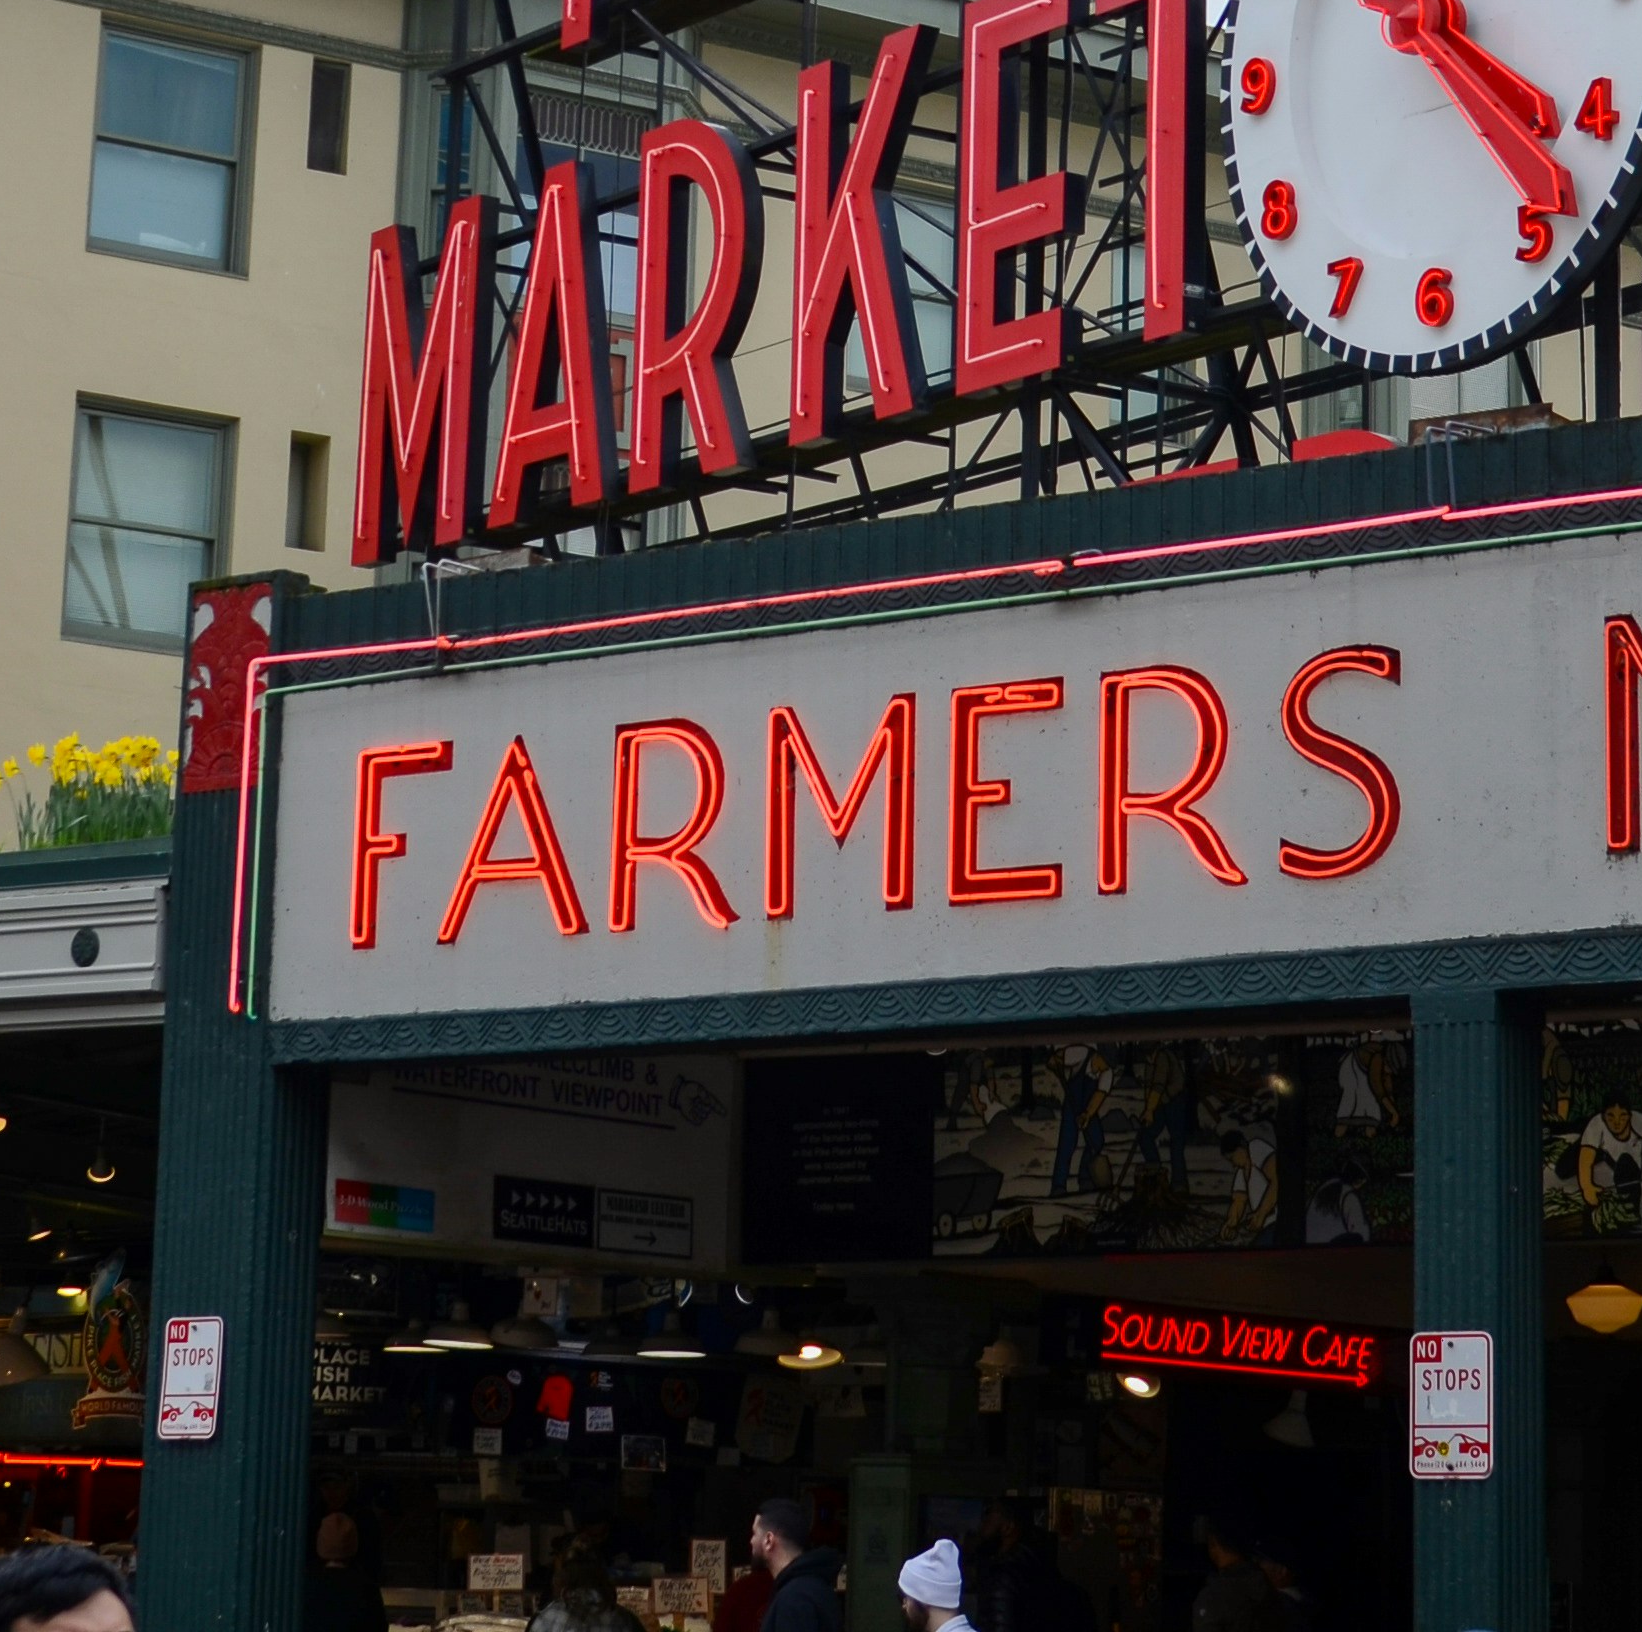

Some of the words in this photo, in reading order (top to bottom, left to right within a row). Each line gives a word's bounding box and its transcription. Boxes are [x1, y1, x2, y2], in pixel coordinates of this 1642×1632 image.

[1240, 57, 1276, 116] 9
[1575, 77, 1620, 141] 4
[1261, 179, 1298, 241] 8
[1515, 206, 1554, 263] 5
[1327, 257, 1364, 319] 7
[1415, 268, 1454, 328] 6
[350, 643, 1402, 949] FARMERS
[551, 1079, 663, 1117] VIEWPOINT
[645, 1063, 658, 1085] &
[170, 1324, 186, 1339] NO
[173, 1348, 214, 1366] STOPS
[1101, 1305, 1211, 1356] SOUND
[1221, 1315, 1295, 1362] VIEW
[1302, 1325, 1374, 1371] CAFE
[1416, 1340, 1437, 1359] NO
[111, 1400, 143, 1413] FAMOU
[1422, 1369, 1481, 1391] STOPS
